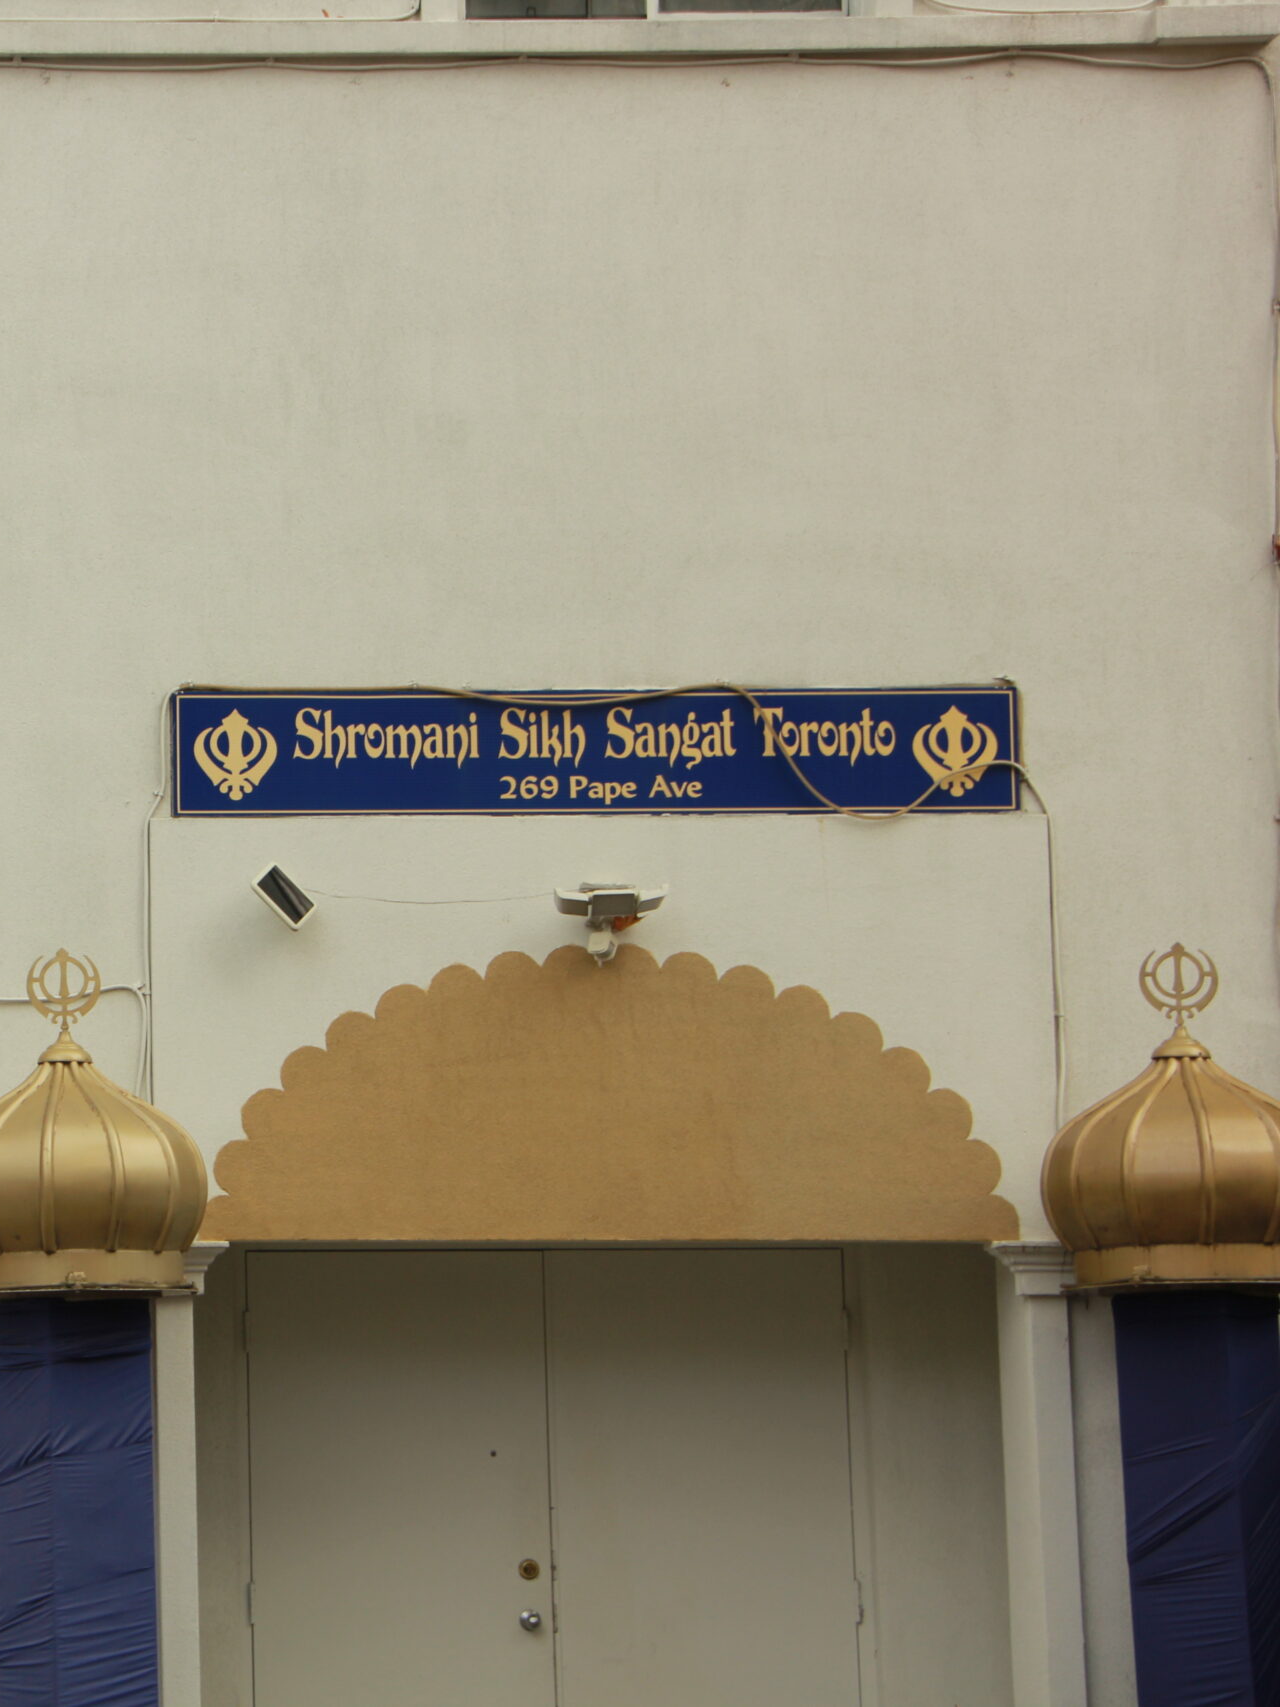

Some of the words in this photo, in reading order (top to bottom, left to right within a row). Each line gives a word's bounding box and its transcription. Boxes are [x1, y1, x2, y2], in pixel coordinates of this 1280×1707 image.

[293, 707, 480, 768] Shromani
[497, 706, 587, 768] Sikh
[603, 706, 736, 768] Sangat
[754, 707, 896, 767] Toronto
[499, 776, 559, 800] 269
[568, 776, 637, 804] Pape
[648, 775, 703, 800] Ave
